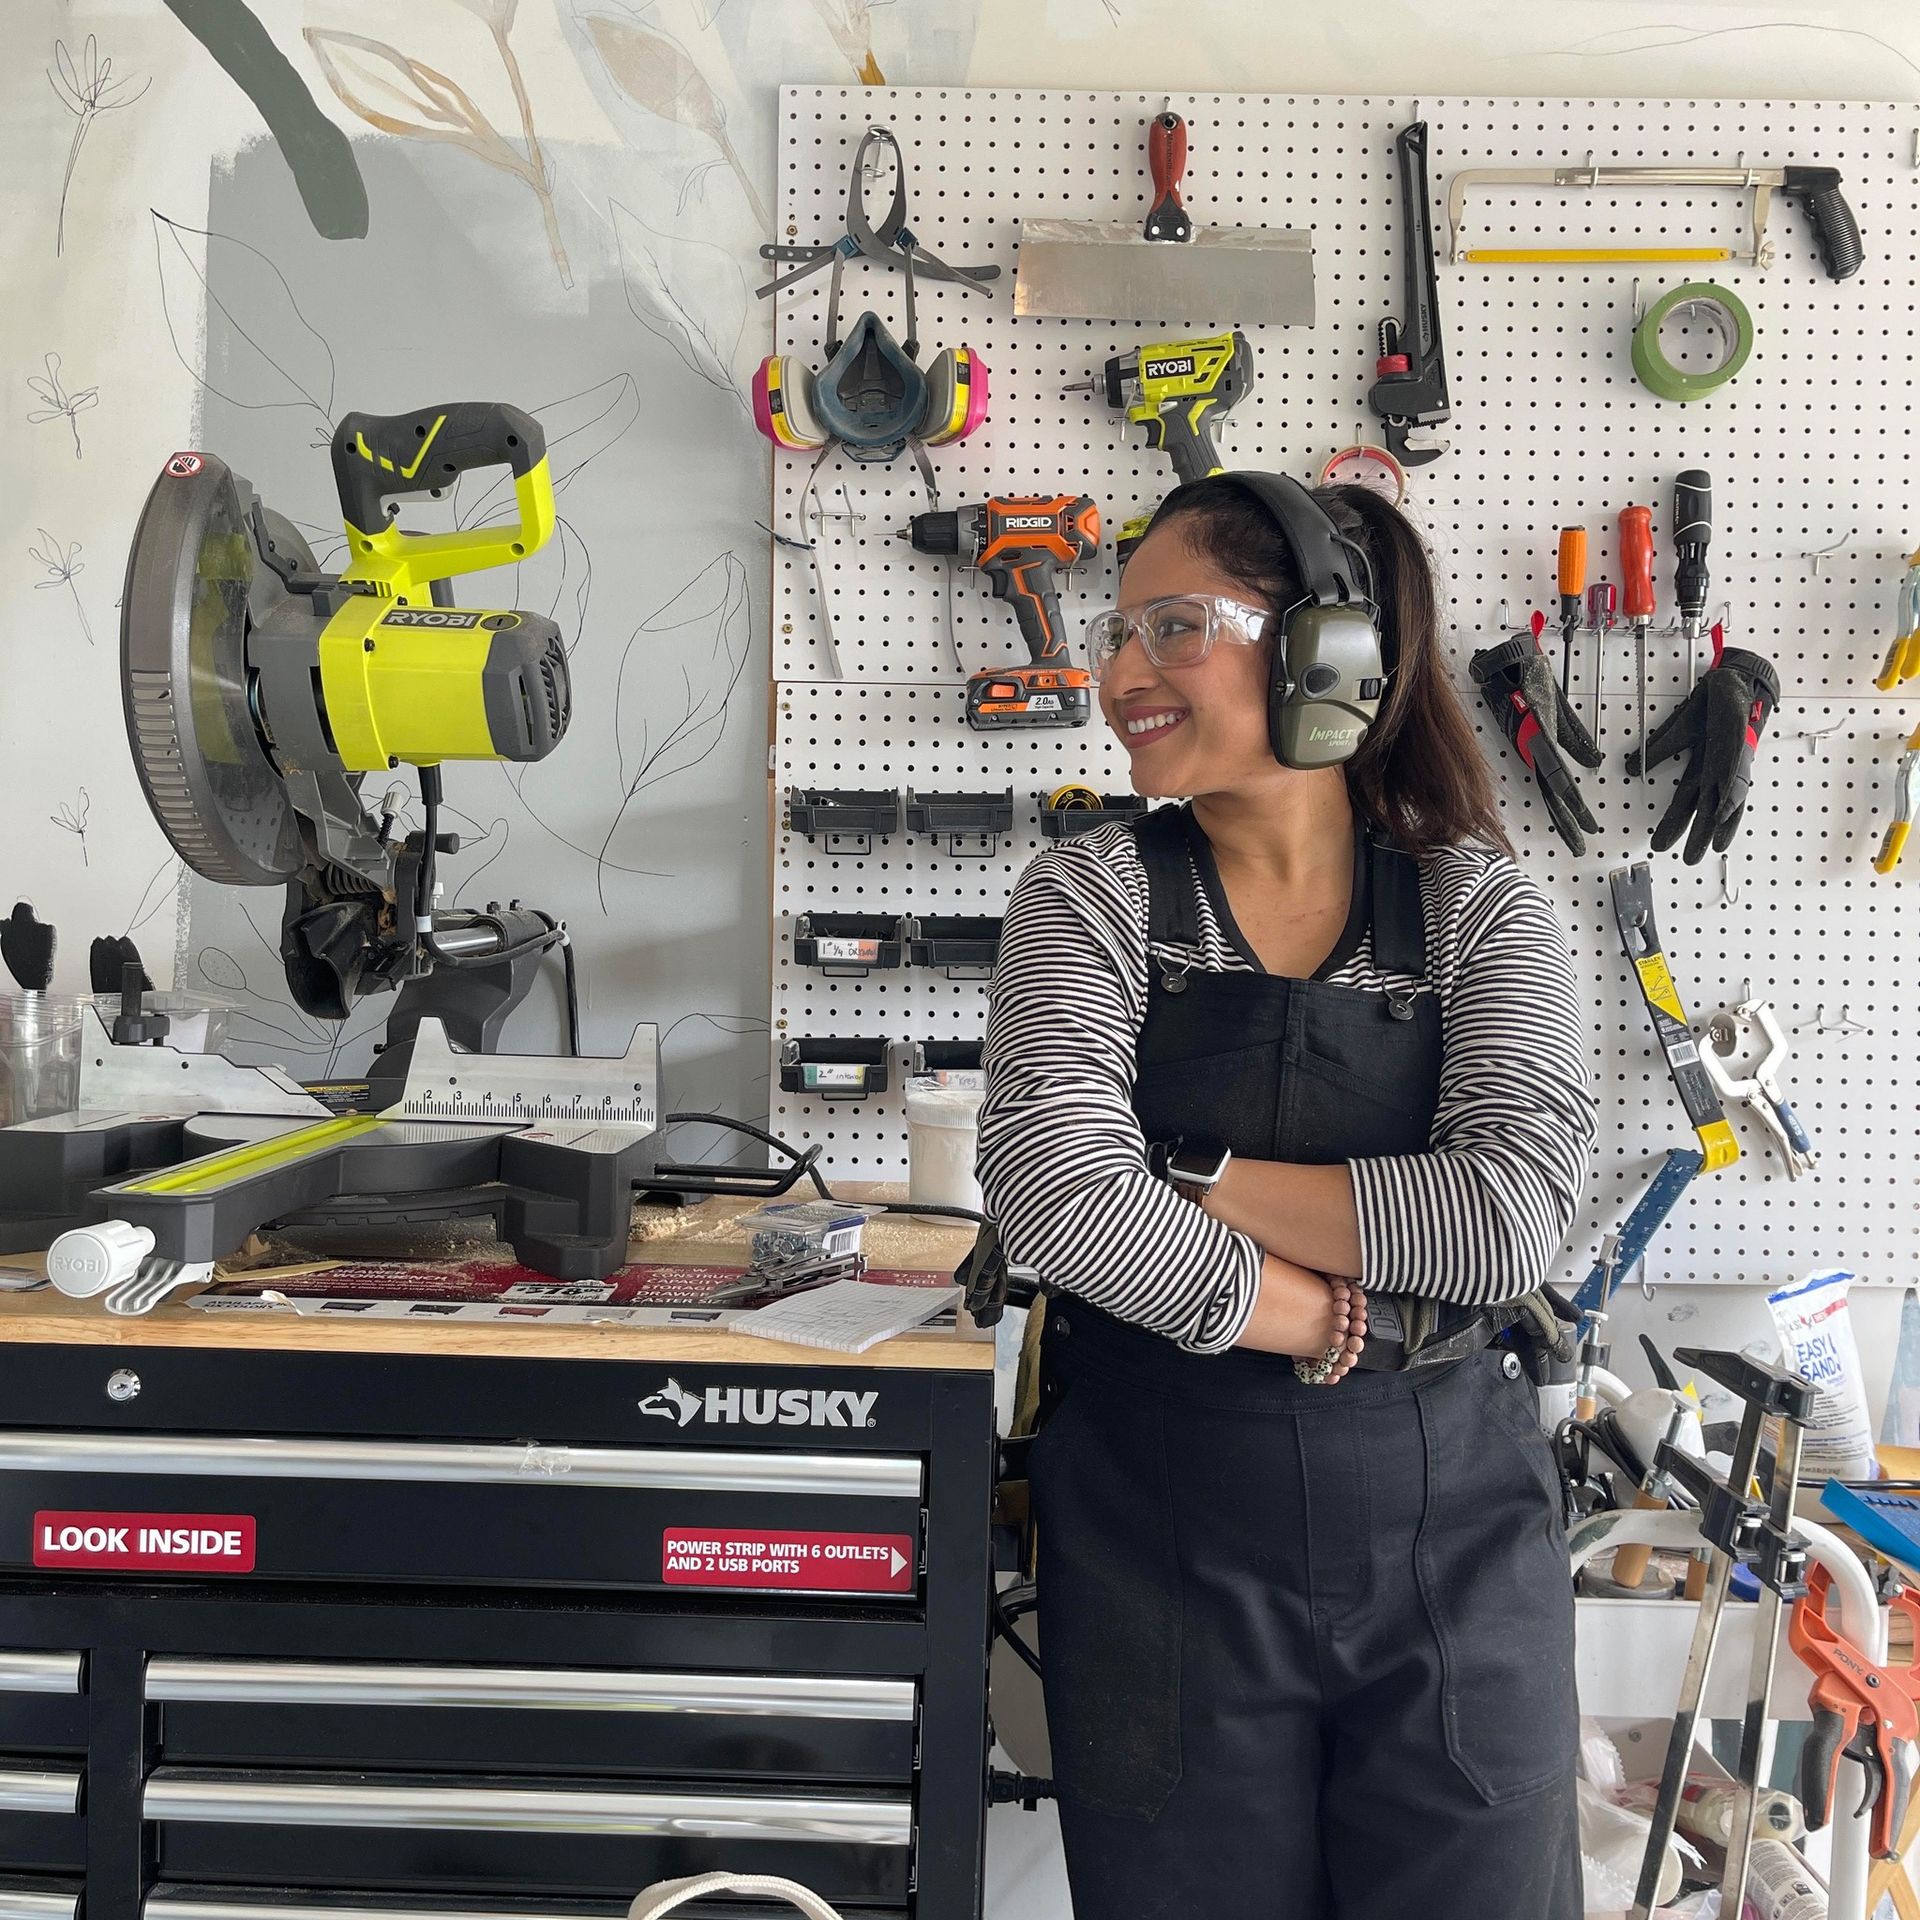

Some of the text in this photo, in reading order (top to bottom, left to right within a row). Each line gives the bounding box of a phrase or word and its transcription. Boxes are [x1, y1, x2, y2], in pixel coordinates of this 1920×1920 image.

[1147, 360, 1191, 376] RYOBI
[1006, 517, 1052, 528] RIDGID
[387, 612, 476, 626] RYOBI
[1309, 727, 1353, 741] IMPACT
[426, 1090, 641, 1106] 2 3 4 5 6 7 8 9
[54, 1256, 101, 1273] RYOBI
[1796, 1336, 1827, 1362] EASY
[1800, 1357, 1837, 1381] SAND
[704, 1387, 879, 1427] HUSKY
[43, 1526, 242, 1556] LOOK INSIDE
[666, 1540, 889, 1560] POWER STRIP WITH 6 OUTLETS
[666, 1556, 800, 1574] AND 2 USB PORTS
[1833, 1648, 1864, 1675] PONY
